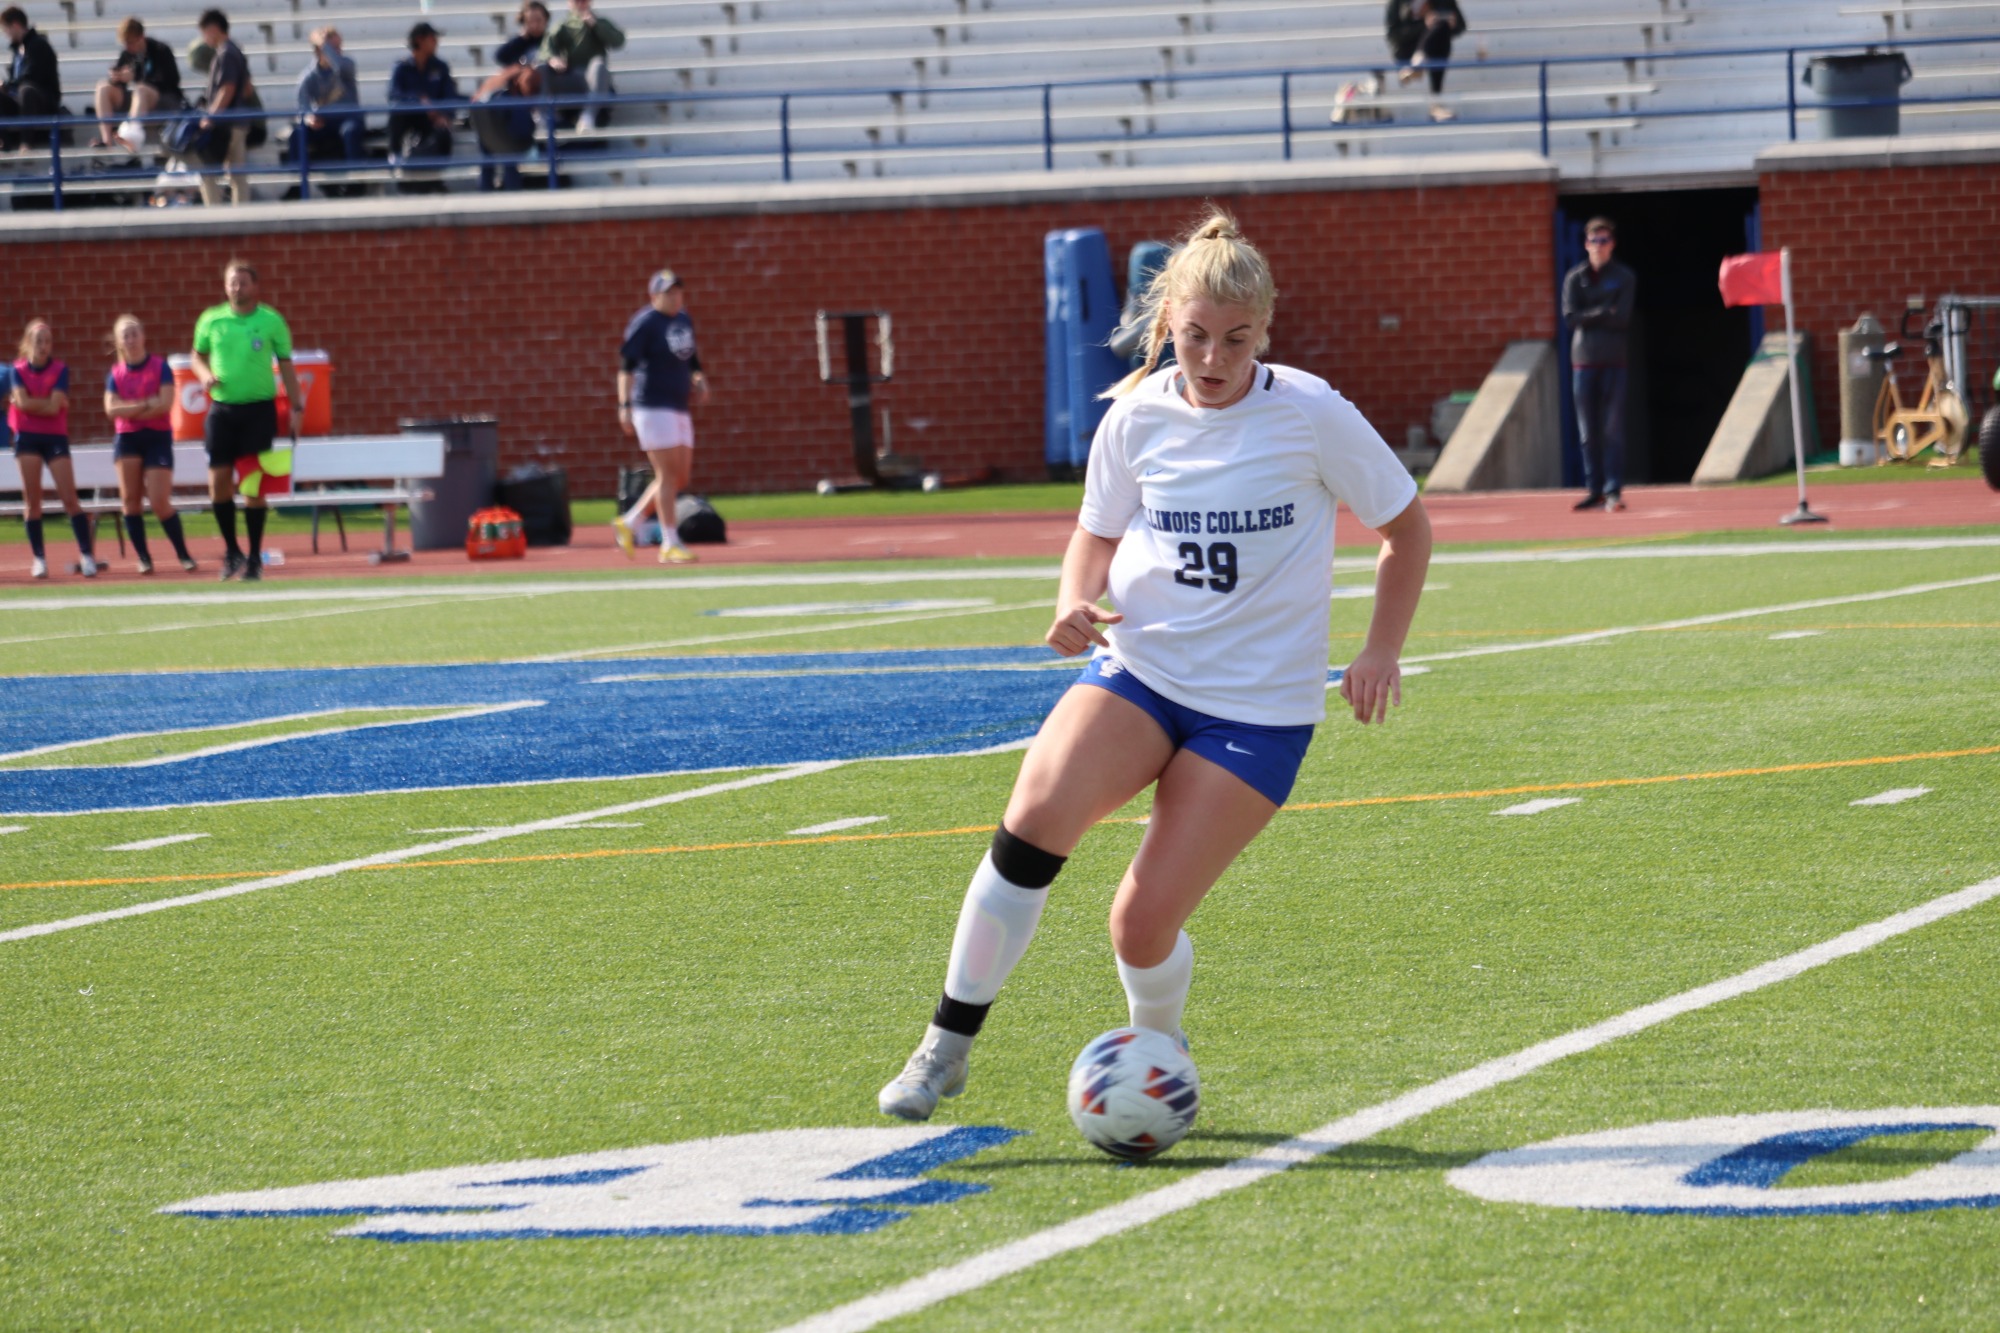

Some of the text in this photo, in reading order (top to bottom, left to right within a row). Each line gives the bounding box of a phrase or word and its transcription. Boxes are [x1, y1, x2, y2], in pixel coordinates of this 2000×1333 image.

[1147, 502, 1295, 534] LINOIS COLLEGE
[1174, 541, 1238, 594] 29
